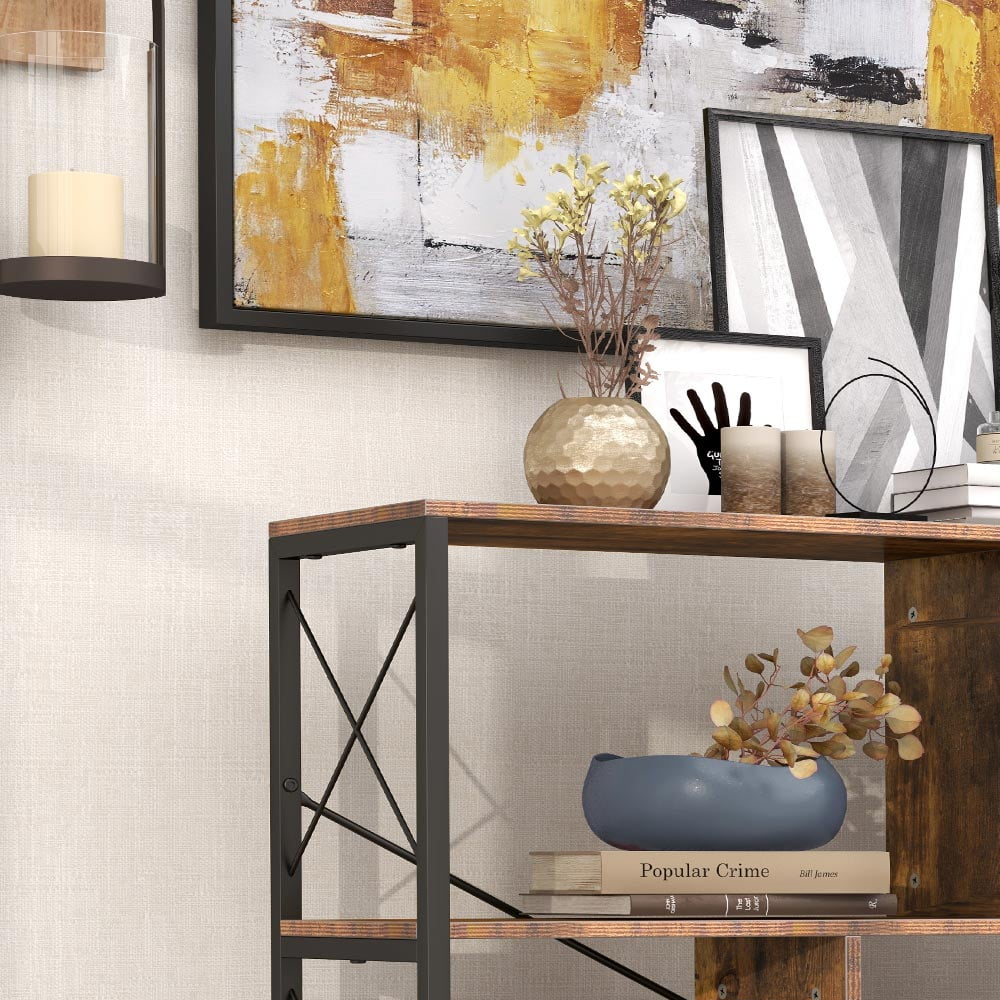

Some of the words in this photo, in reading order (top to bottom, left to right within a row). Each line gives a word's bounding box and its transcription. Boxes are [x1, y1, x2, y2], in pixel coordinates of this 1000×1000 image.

[640, 862, 711, 881] Popular
[716, 862, 770, 878] Crime
[799, 869, 813, 878] Bill
[814, 869, 839, 879] James
